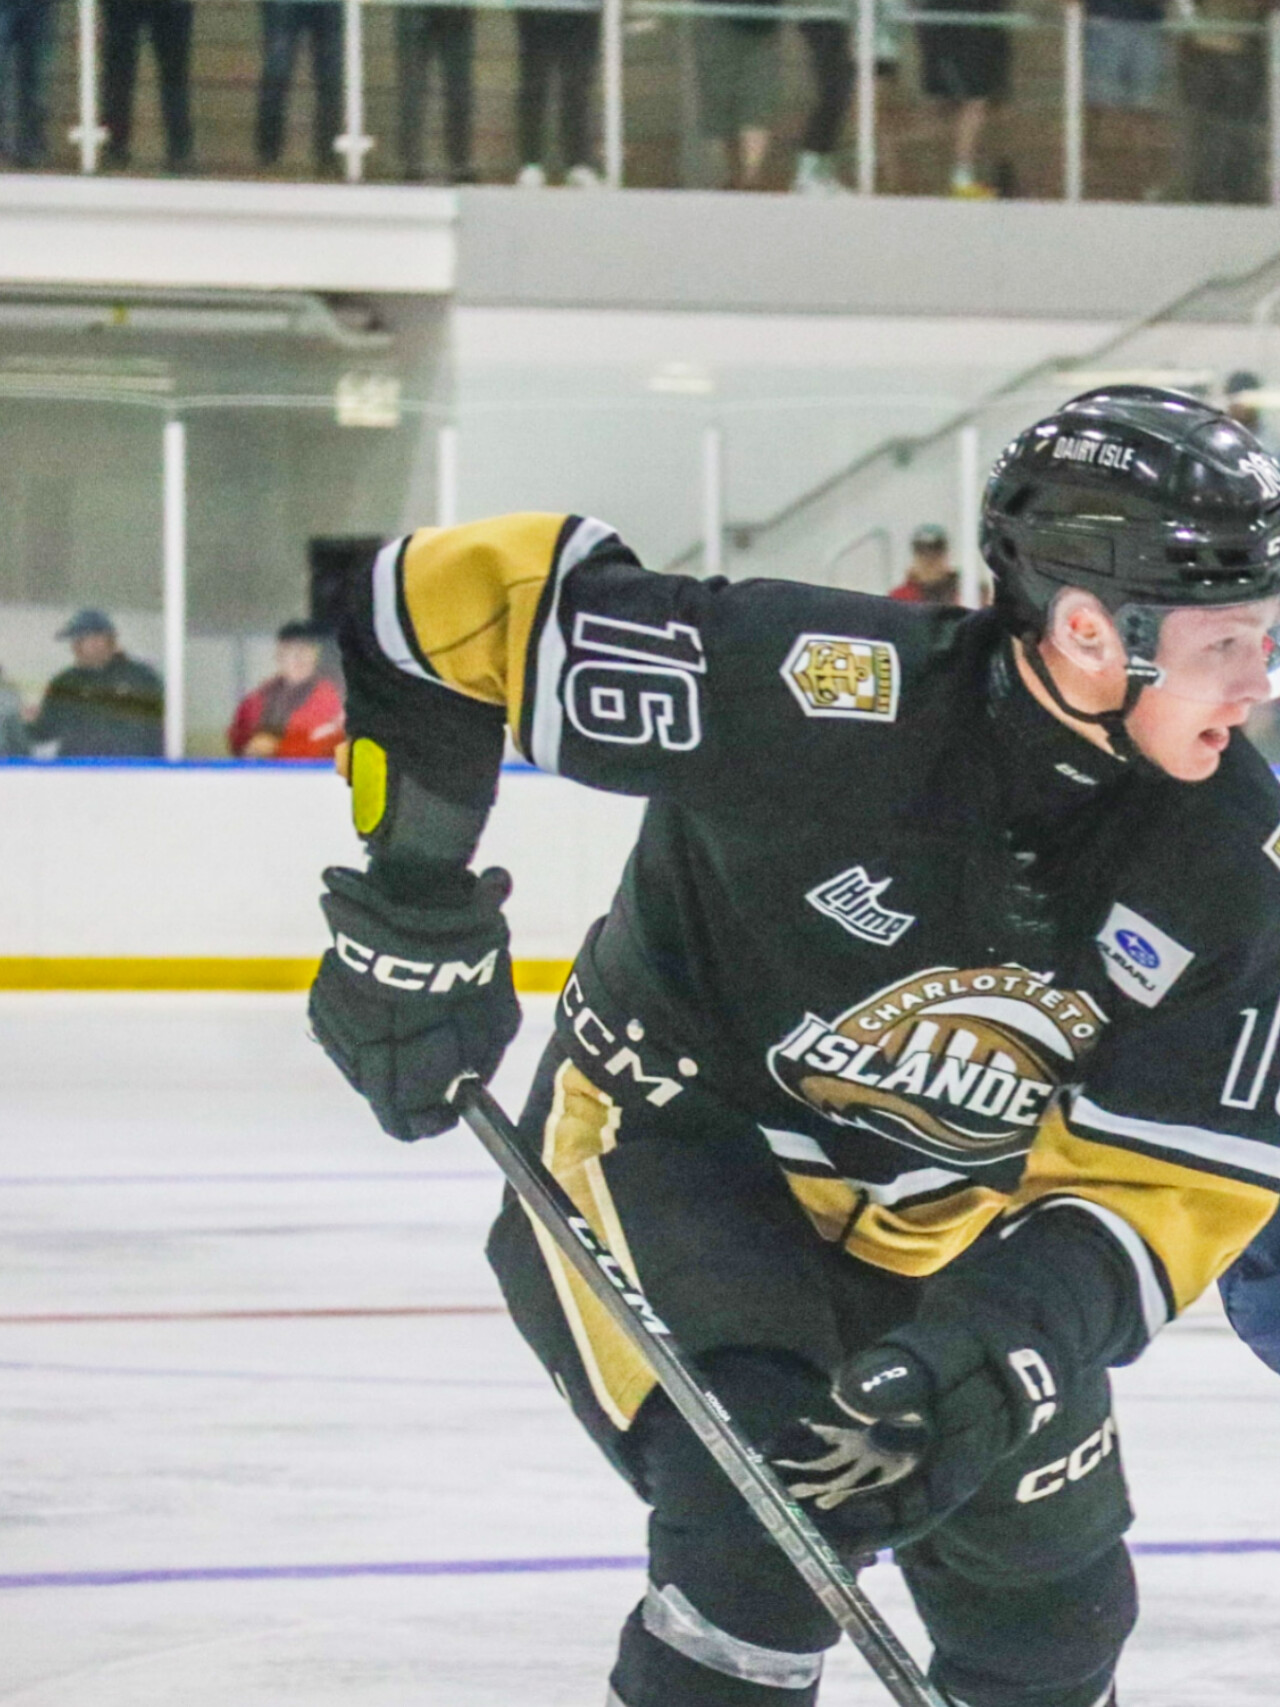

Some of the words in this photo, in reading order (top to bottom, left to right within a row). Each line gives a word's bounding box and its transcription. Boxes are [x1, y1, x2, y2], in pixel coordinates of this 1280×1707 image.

[1053, 436, 1100, 463] DAIRY
[1098, 443, 1135, 471] ISLE
[564, 612, 707, 752] 16
[336, 932, 499, 993] CCM
[858, 973, 1095, 1040] CHARLOTTETO
[563, 972, 684, 1108] CCM
[781, 1018, 1054, 1128] ISLANDE
[568, 1216, 671, 1334] CCM
